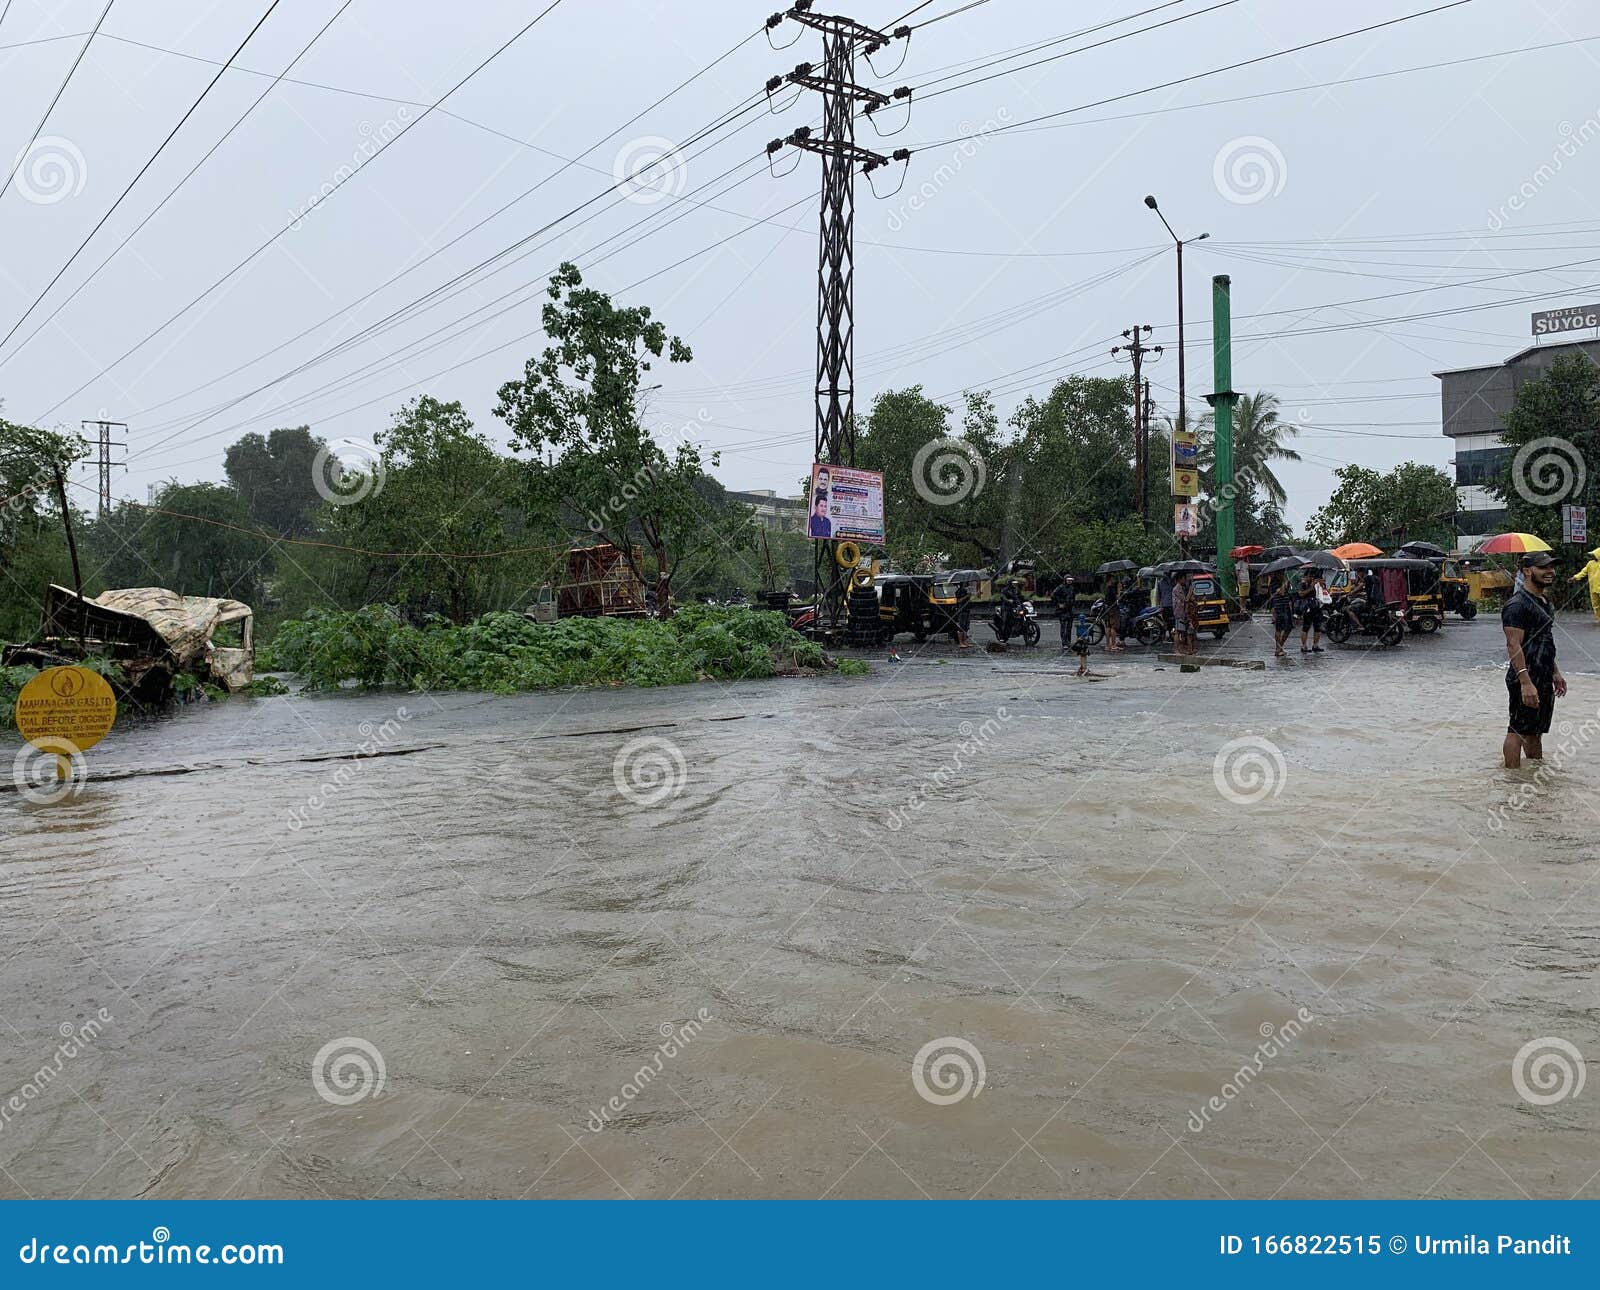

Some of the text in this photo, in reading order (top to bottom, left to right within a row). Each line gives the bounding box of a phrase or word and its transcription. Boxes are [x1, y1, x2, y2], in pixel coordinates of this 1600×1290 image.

[1547, 308, 1584, 318] HOTEL
[1536, 314, 1597, 333] SUYOG
[19, 698, 74, 708] MAHANAGAR
[21, 714, 111, 726] DIAL BEFORE DIGGING
